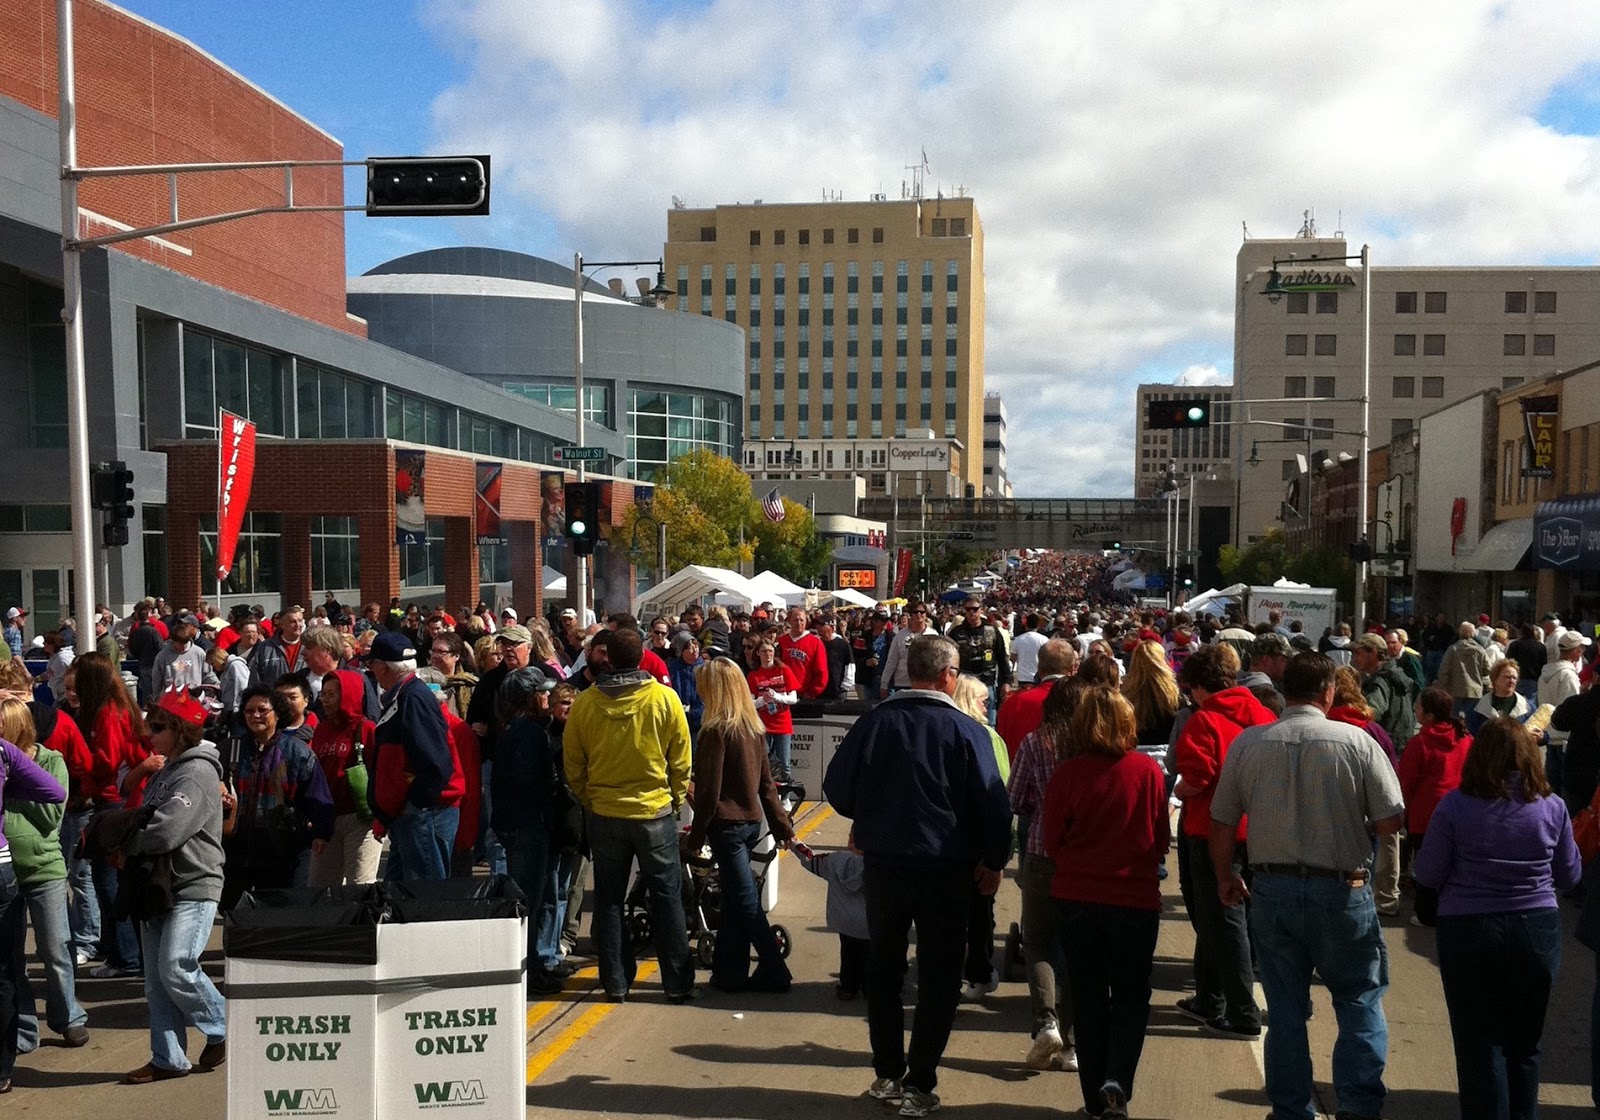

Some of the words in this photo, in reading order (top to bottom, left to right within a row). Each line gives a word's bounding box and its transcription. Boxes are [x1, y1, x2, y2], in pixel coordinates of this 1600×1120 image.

[1267, 269, 1356, 287] adisson
[1535, 416, 1553, 467] LAMP
[564, 448, 591, 459] Walnut
[593, 448, 603, 459] St
[222, 418, 246, 518] Wristb
[1072, 522, 1123, 539] Radisson
[1542, 529, 1557, 547] The
[1563, 528, 1579, 546] Bar
[479, 536, 500, 546] Where
[1258, 599, 1284, 609] Papa
[1286, 600, 1327, 611] Murphy's
[790, 734, 814, 742] RASH
[256, 1015, 351, 1035] TRASH
[405, 1008, 497, 1030] TRASH
[265, 1042, 341, 1062] ONLY
[415, 1034, 488, 1056] ONLY
[264, 1088, 338, 1110] WM
[414, 1080, 486, 1103] WM
